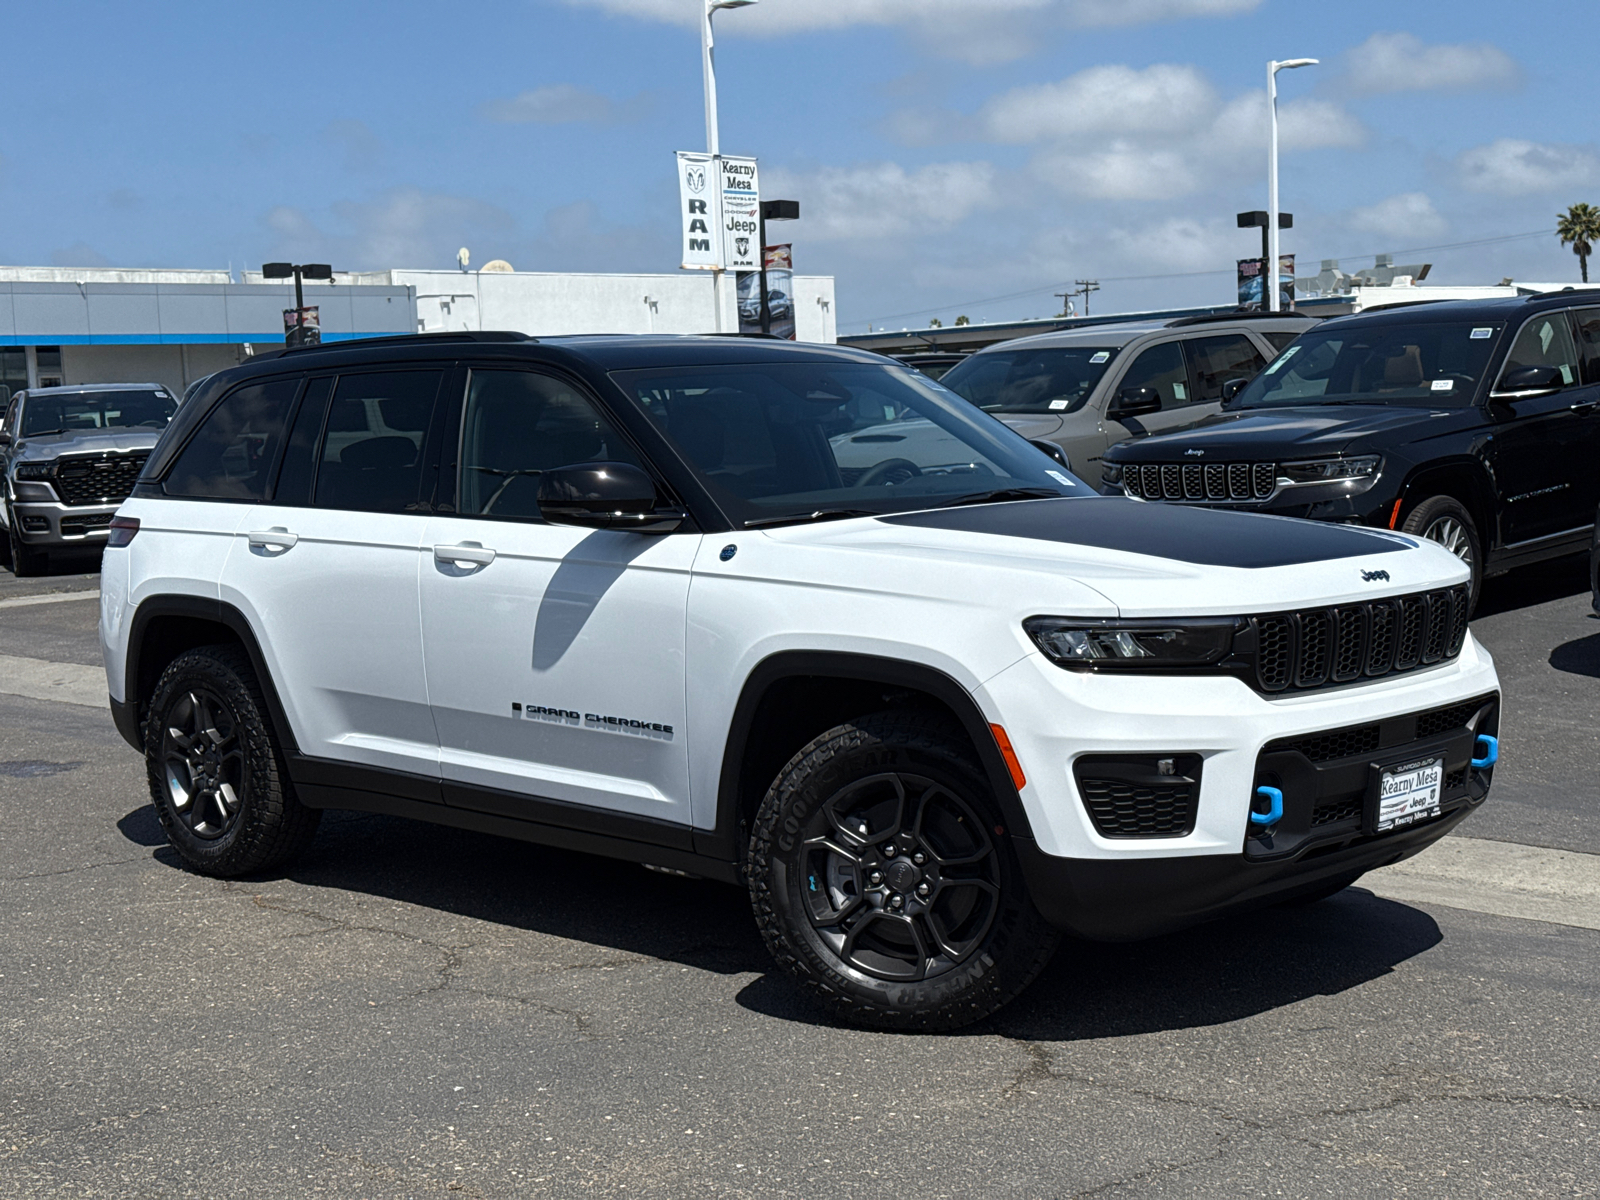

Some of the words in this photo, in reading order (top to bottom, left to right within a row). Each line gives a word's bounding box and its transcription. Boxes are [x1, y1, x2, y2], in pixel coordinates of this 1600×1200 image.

[722, 161, 755, 179] Kearny
[727, 176, 752, 190] Mesa
[688, 199, 710, 251] RAM
[726, 216, 757, 235] Jeep
[1360, 569, 1390, 582] Jeep
[526, 704, 580, 719] GRAND
[585, 713, 674, 734] CHEROKEE
[1381, 777, 1415, 795] Kearny
[1416, 771, 1438, 787] Mesa
[1410, 797, 1427, 809] Jeep
